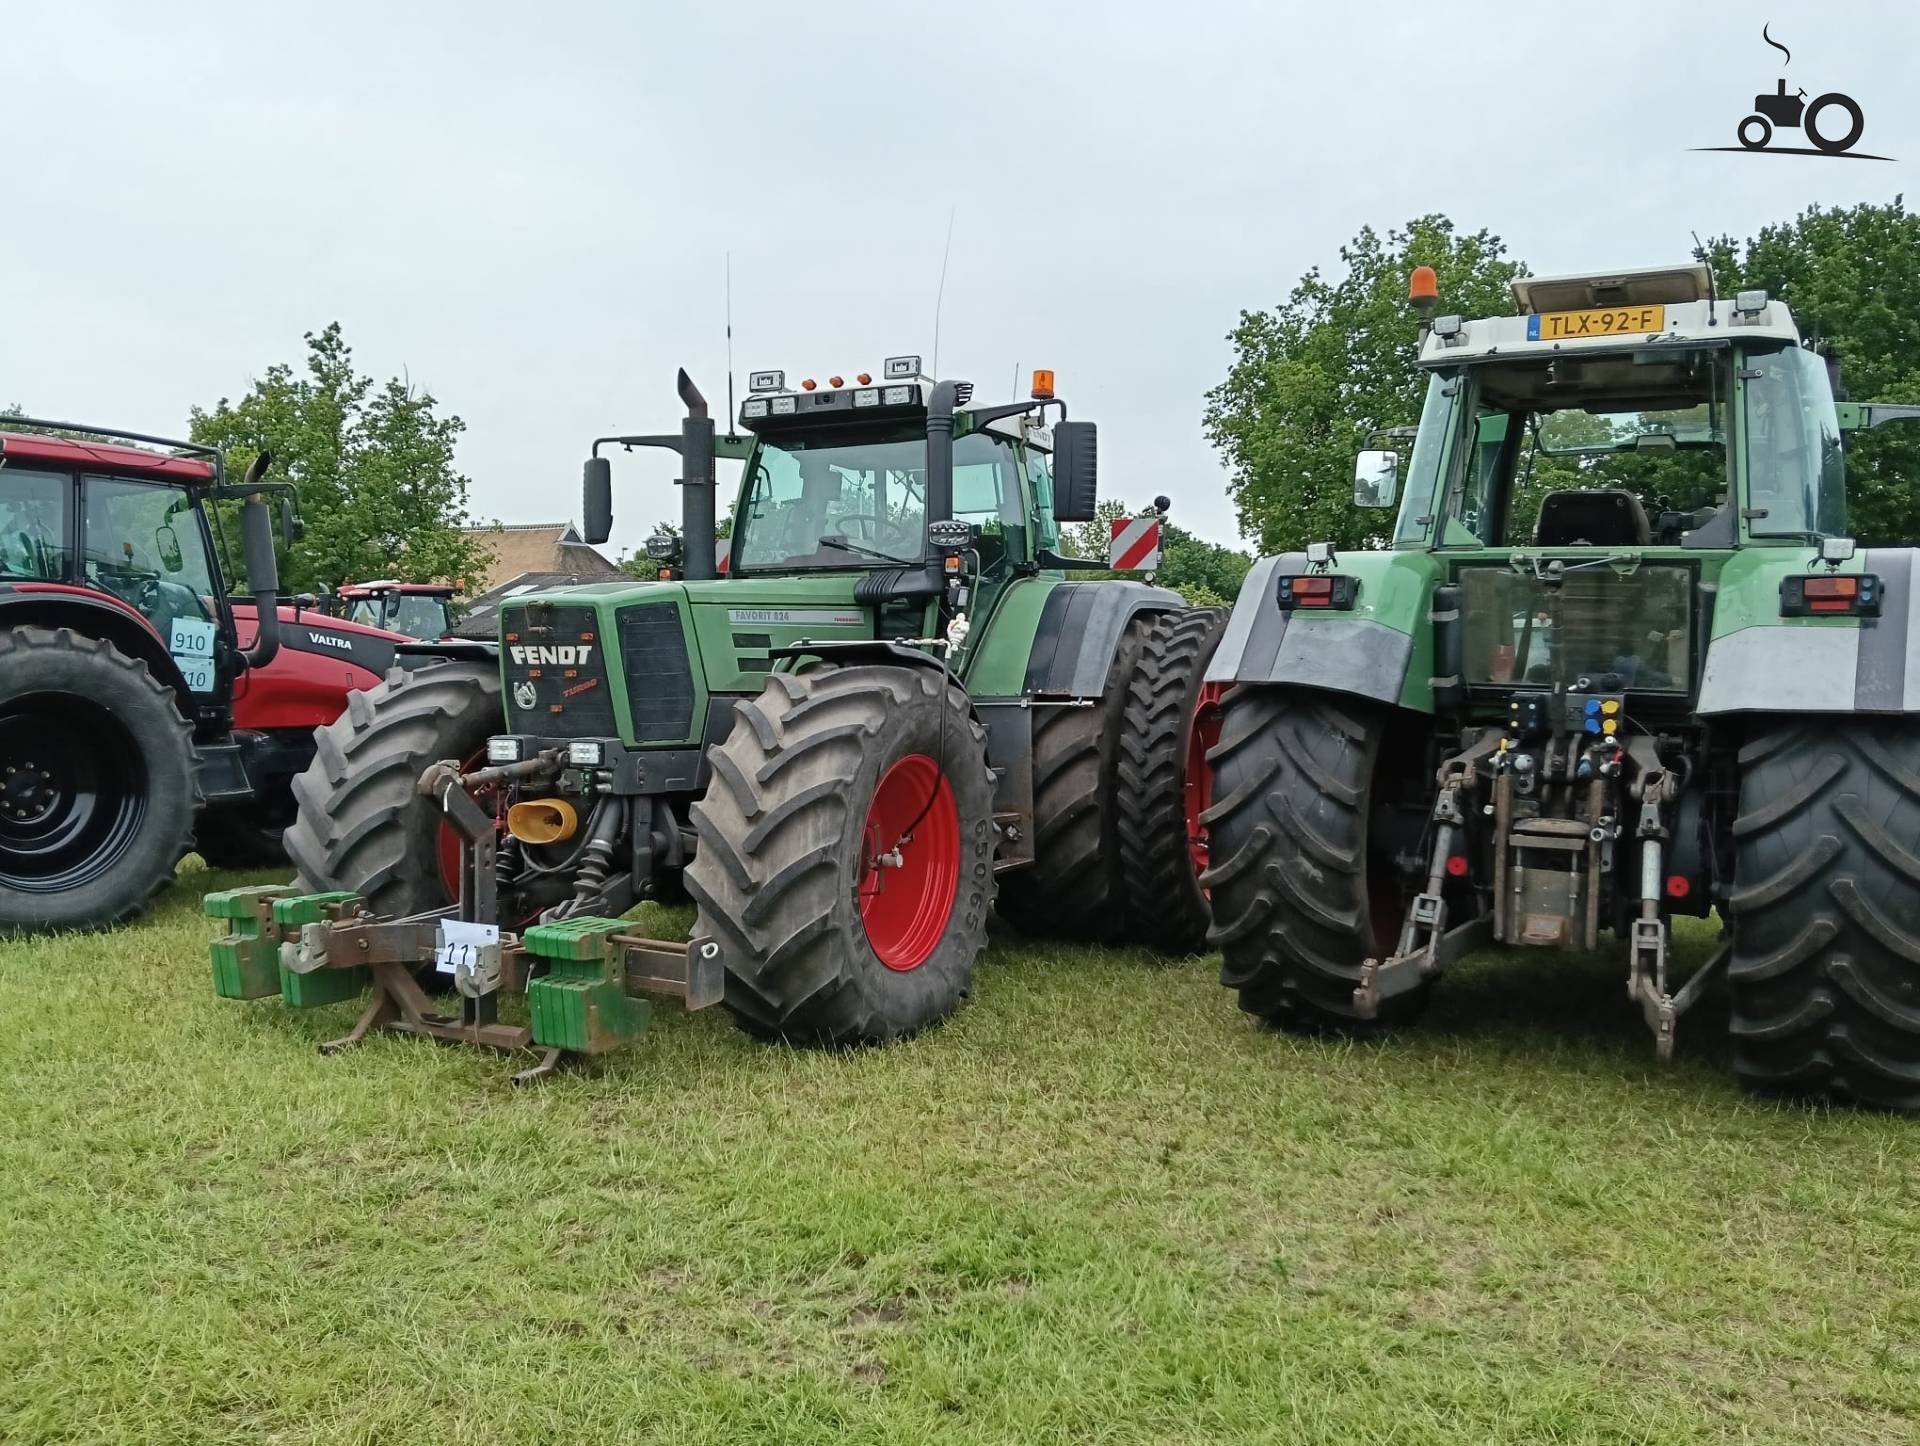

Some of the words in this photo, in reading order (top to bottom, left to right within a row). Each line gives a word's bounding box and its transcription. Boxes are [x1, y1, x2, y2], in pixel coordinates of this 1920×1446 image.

[1549, 310, 1653, 336] TLX-92-F
[735, 610, 770, 620] FAVORIT
[175, 632, 206, 651] 910
[308, 632, 353, 650] VALTRA
[509, 645, 593, 665] FENDT
[182, 671, 206, 687] 10
[966, 819, 988, 932] 650/65
